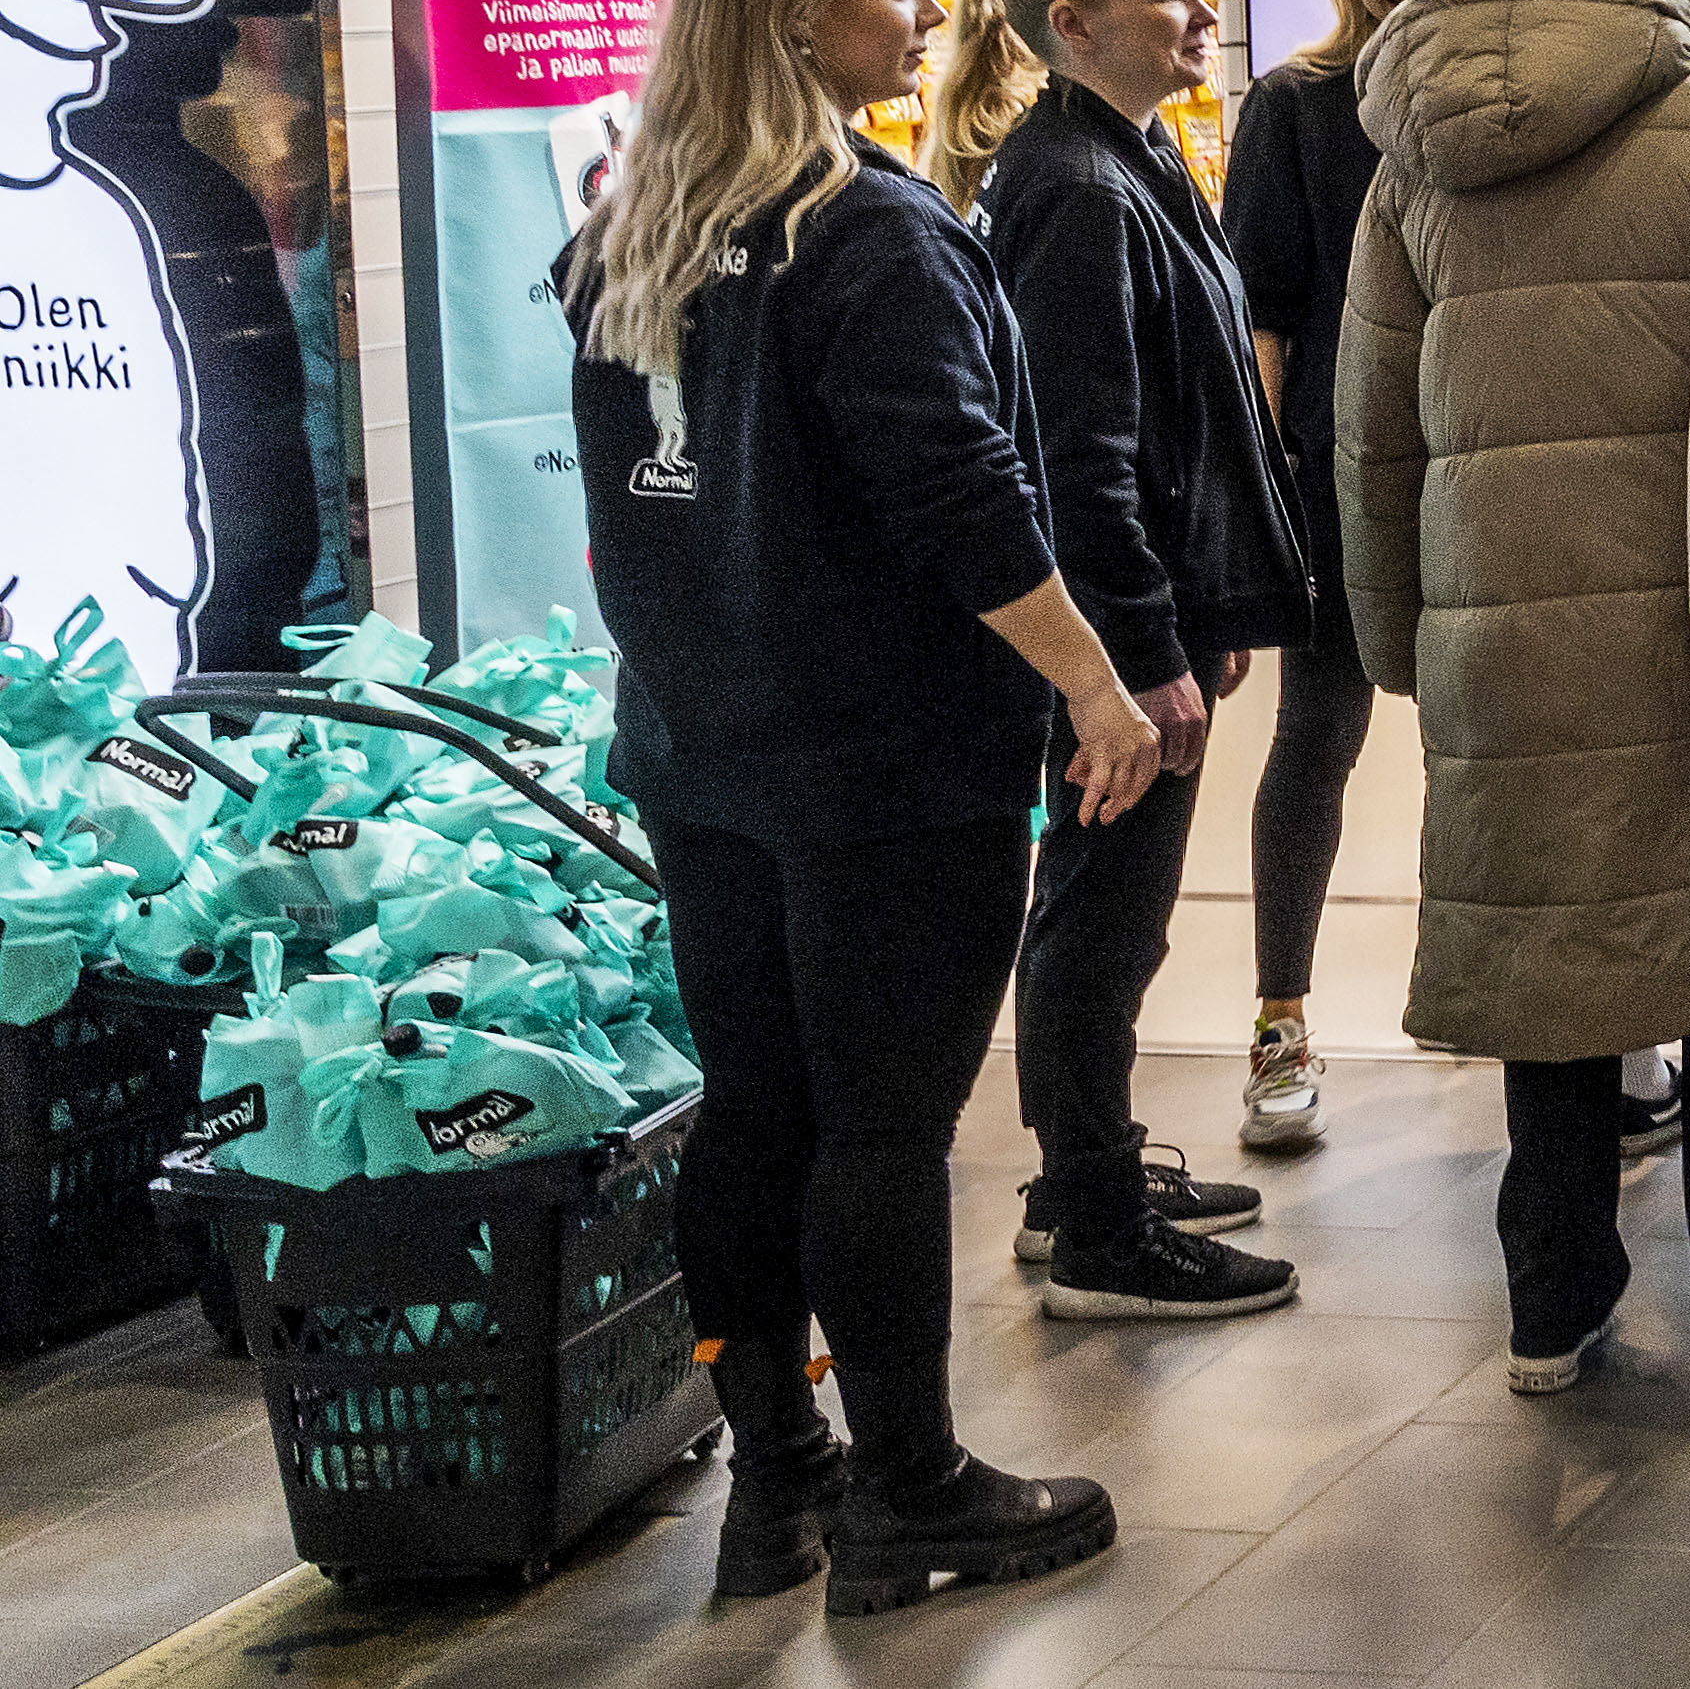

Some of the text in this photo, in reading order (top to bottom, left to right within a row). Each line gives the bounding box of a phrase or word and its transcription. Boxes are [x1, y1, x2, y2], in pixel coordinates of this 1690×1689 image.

[516, 56, 544, 80] ja
[0, 282, 109, 330] Olen
[641, 467, 694, 490] Normal
[99, 739, 193, 793] Normal
